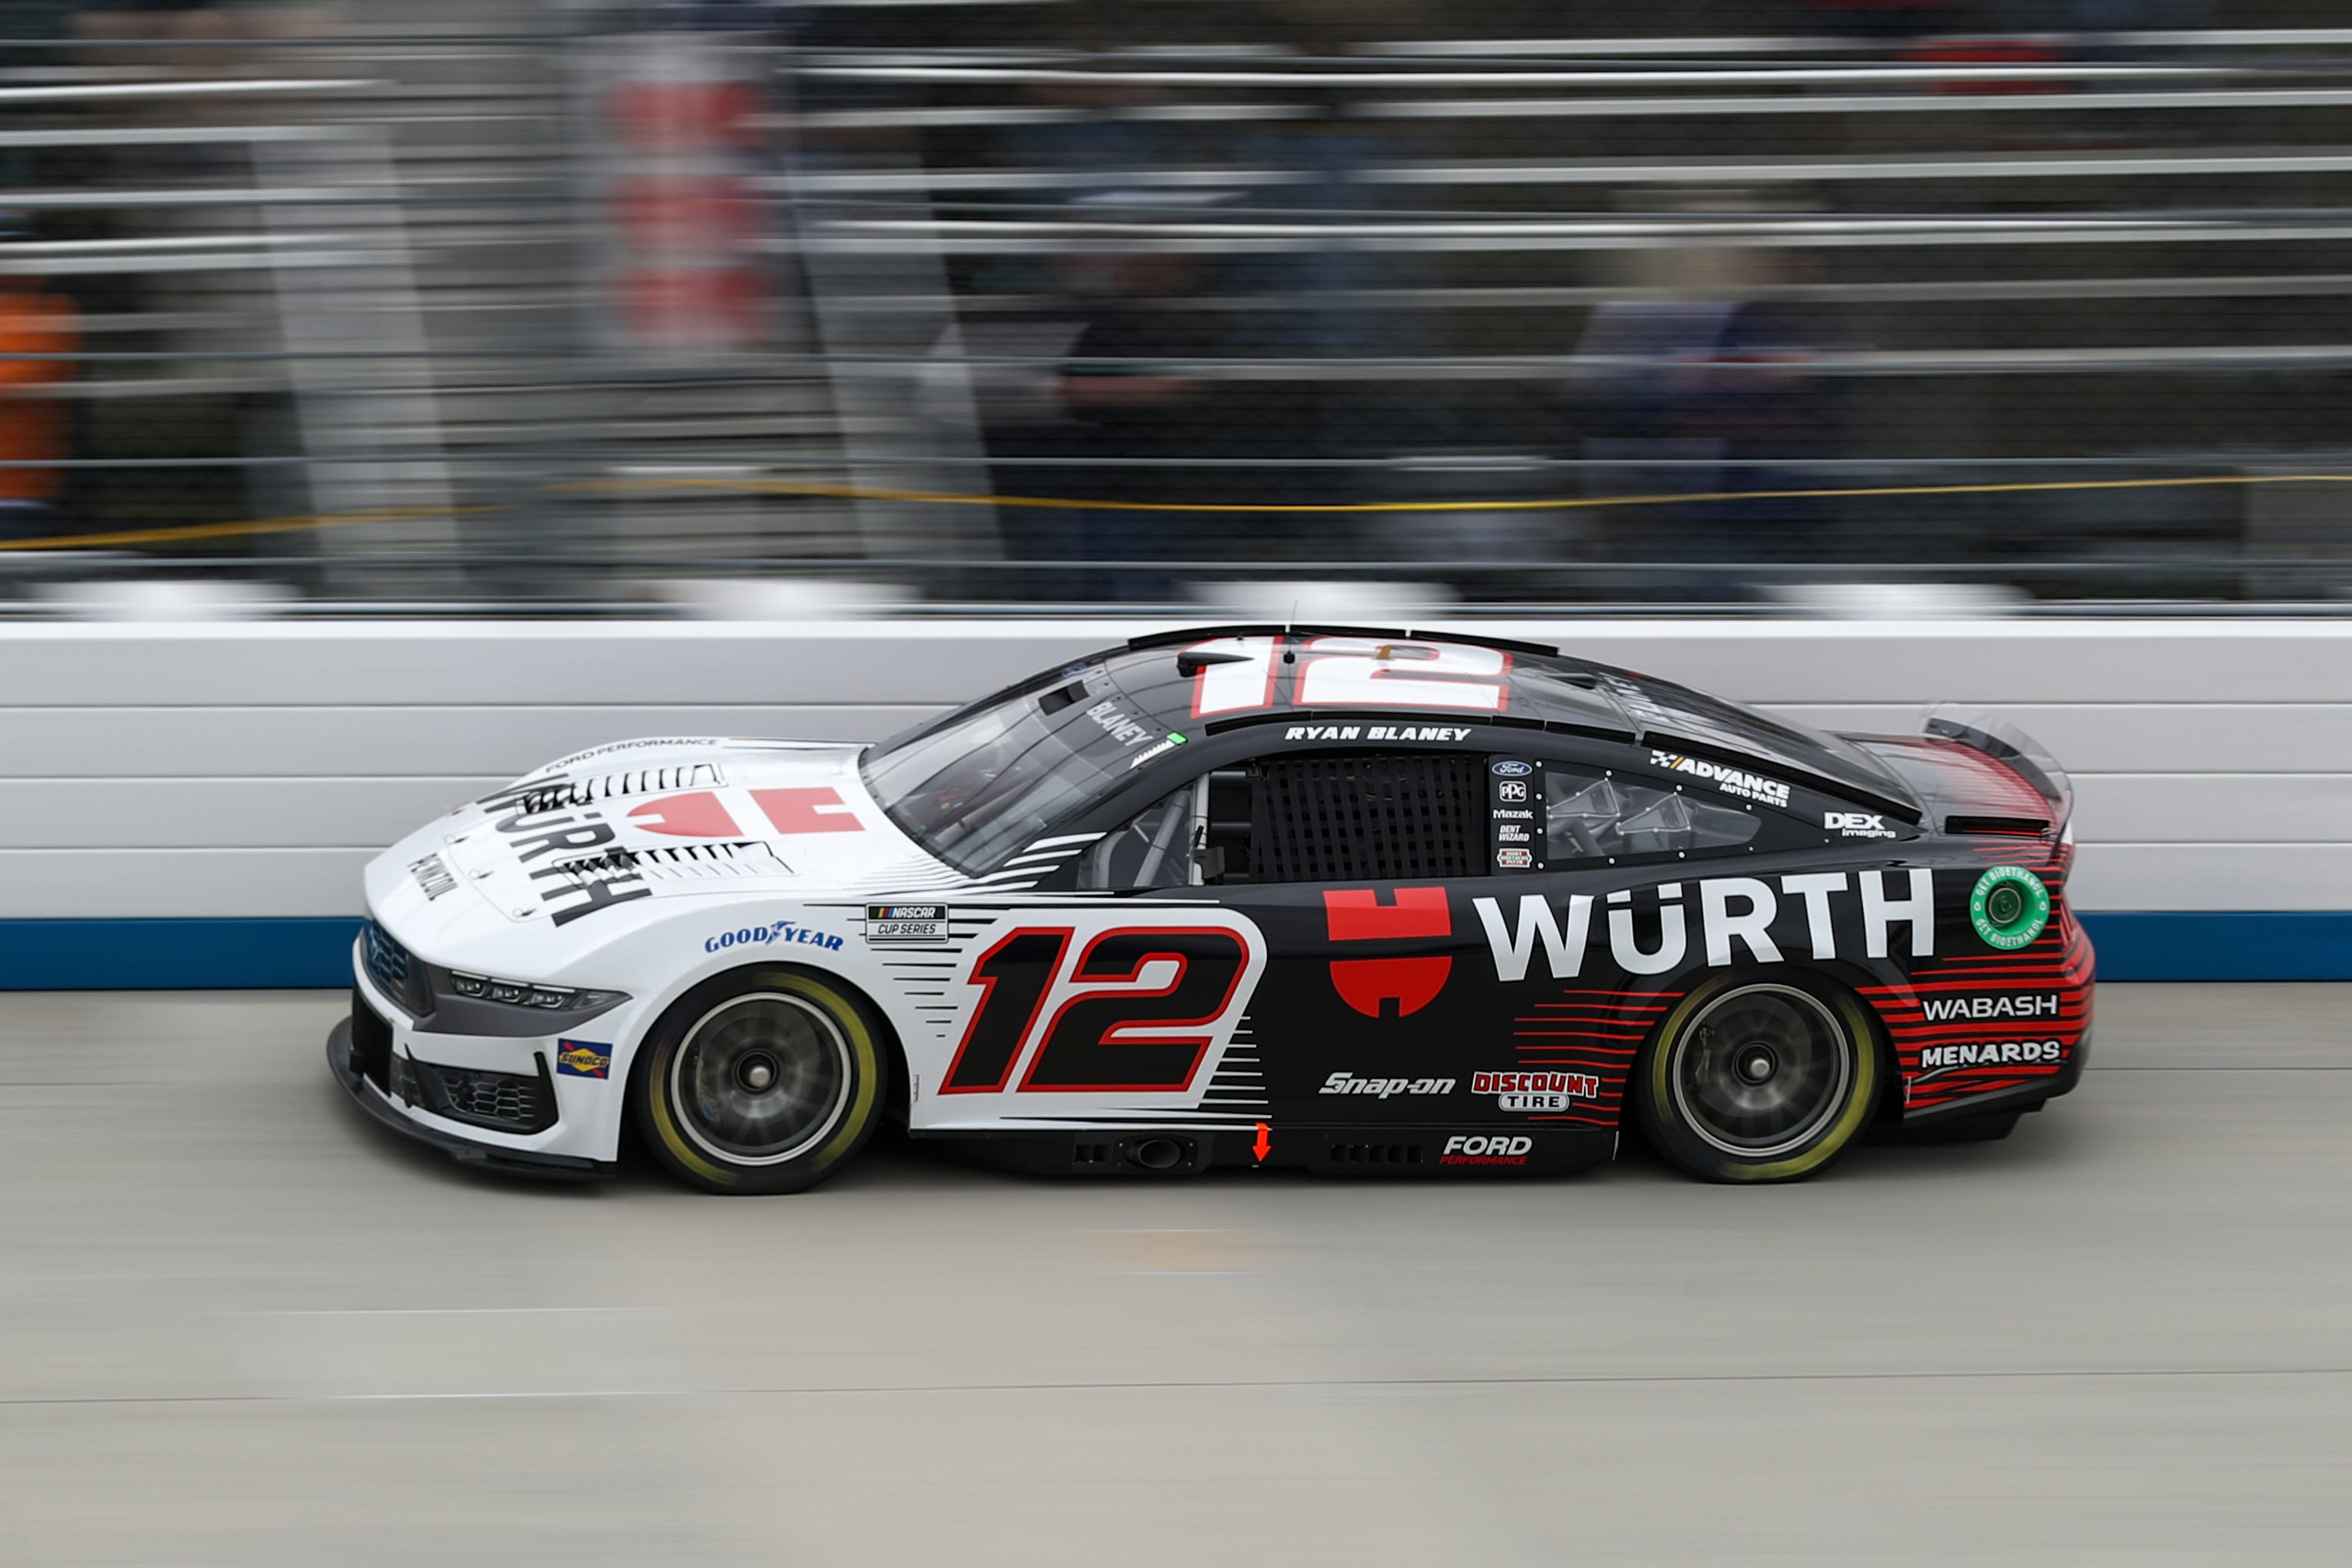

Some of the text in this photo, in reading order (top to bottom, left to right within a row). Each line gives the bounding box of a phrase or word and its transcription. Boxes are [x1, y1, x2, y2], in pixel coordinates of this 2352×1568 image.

[1176, 636, 1513, 719] 12
[1086, 701, 1153, 746] BLANEY
[1285, 726, 1472, 741] RYAN BLANEY
[545, 738, 718, 772] FORD PERFORMANCE
[1676, 757, 1791, 799] ADVANCE
[1502, 783, 1524, 799] PPG
[1720, 782, 1788, 808] AUTO PARTS
[1493, 809, 1533, 819] Mazak
[1823, 812, 1885, 830] DEX
[1499, 833, 1530, 842] WIZARD
[1500, 825, 1521, 833] DENT
[1842, 829, 1897, 839] imaging
[1975, 876, 1990, 896] GET
[892, 907, 936, 919] NASCAR
[878, 924, 936, 934] CUP SERIES
[1472, 868, 1934, 982] WÜRTH
[1976, 918, 2043, 947] GET BIOETHANOL
[937, 926, 1250, 1096] 12
[1923, 995, 2058, 1021] WABASH
[559, 1053, 609, 1067] SUNOCO
[1921, 1041, 2061, 1069] MENARDS
[1319, 1072, 1456, 1099] Snap-on
[1471, 1071, 1600, 1098] DISCOUNT
[1506, 1095, 1561, 1108] TIRE
[1443, 1136, 1533, 1155] FORD
[1440, 1155, 1527, 1166] PERFORMANCE
